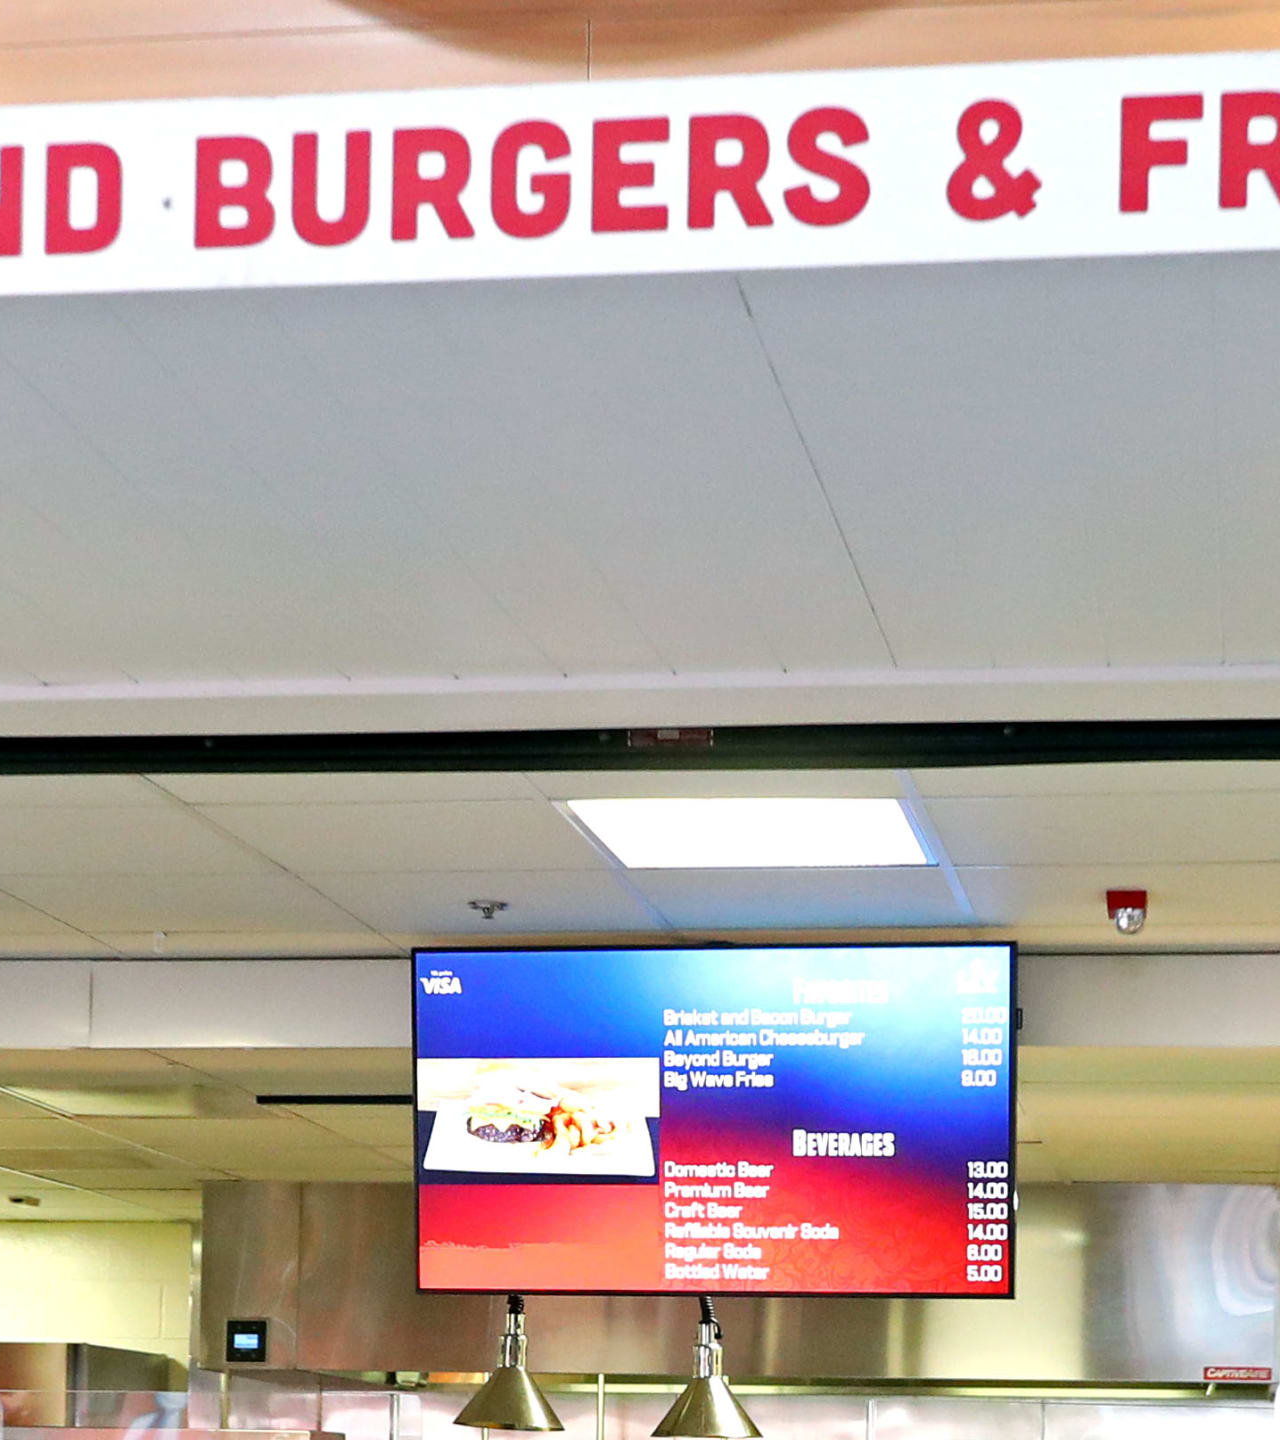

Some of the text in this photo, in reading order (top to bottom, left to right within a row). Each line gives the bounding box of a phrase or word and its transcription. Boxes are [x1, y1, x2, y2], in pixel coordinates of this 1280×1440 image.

[196, 108, 869, 247] BURGERS
[948, 100, 1040, 220] &
[420, 976, 463, 995] VISA
[664, 1009, 719, 1026] Brisket
[720, 1010, 750, 1026] and
[800, 1009, 853, 1028] Burger
[664, 1028, 1003, 1049] All American Cheeseburger 14.00
[664, 1050, 720, 1069] Beyond
[722, 1050, 774, 1070] Burger
[664, 1071, 688, 1091] Big
[689, 1071, 733, 1088] Wave
[735, 1071, 774, 1088] Fries
[793, 1129, 895, 1157] BEVERAGES
[664, 1161, 1008, 1178] Domestic Beer 13.00
[664, 1181, 1008, 1199] Premium Beer 14.00
[664, 1201, 1008, 1219] Craft Beer 15.00
[732, 1222, 800, 1239] Souvenir
[800, 1222, 839, 1239] Soda
[967, 1223, 1008, 1240] 14.00
[664, 1243, 722, 1262] Regular
[722, 1243, 762, 1260] Soda
[664, 1263, 1002, 1282] Bottled Water 5.00
